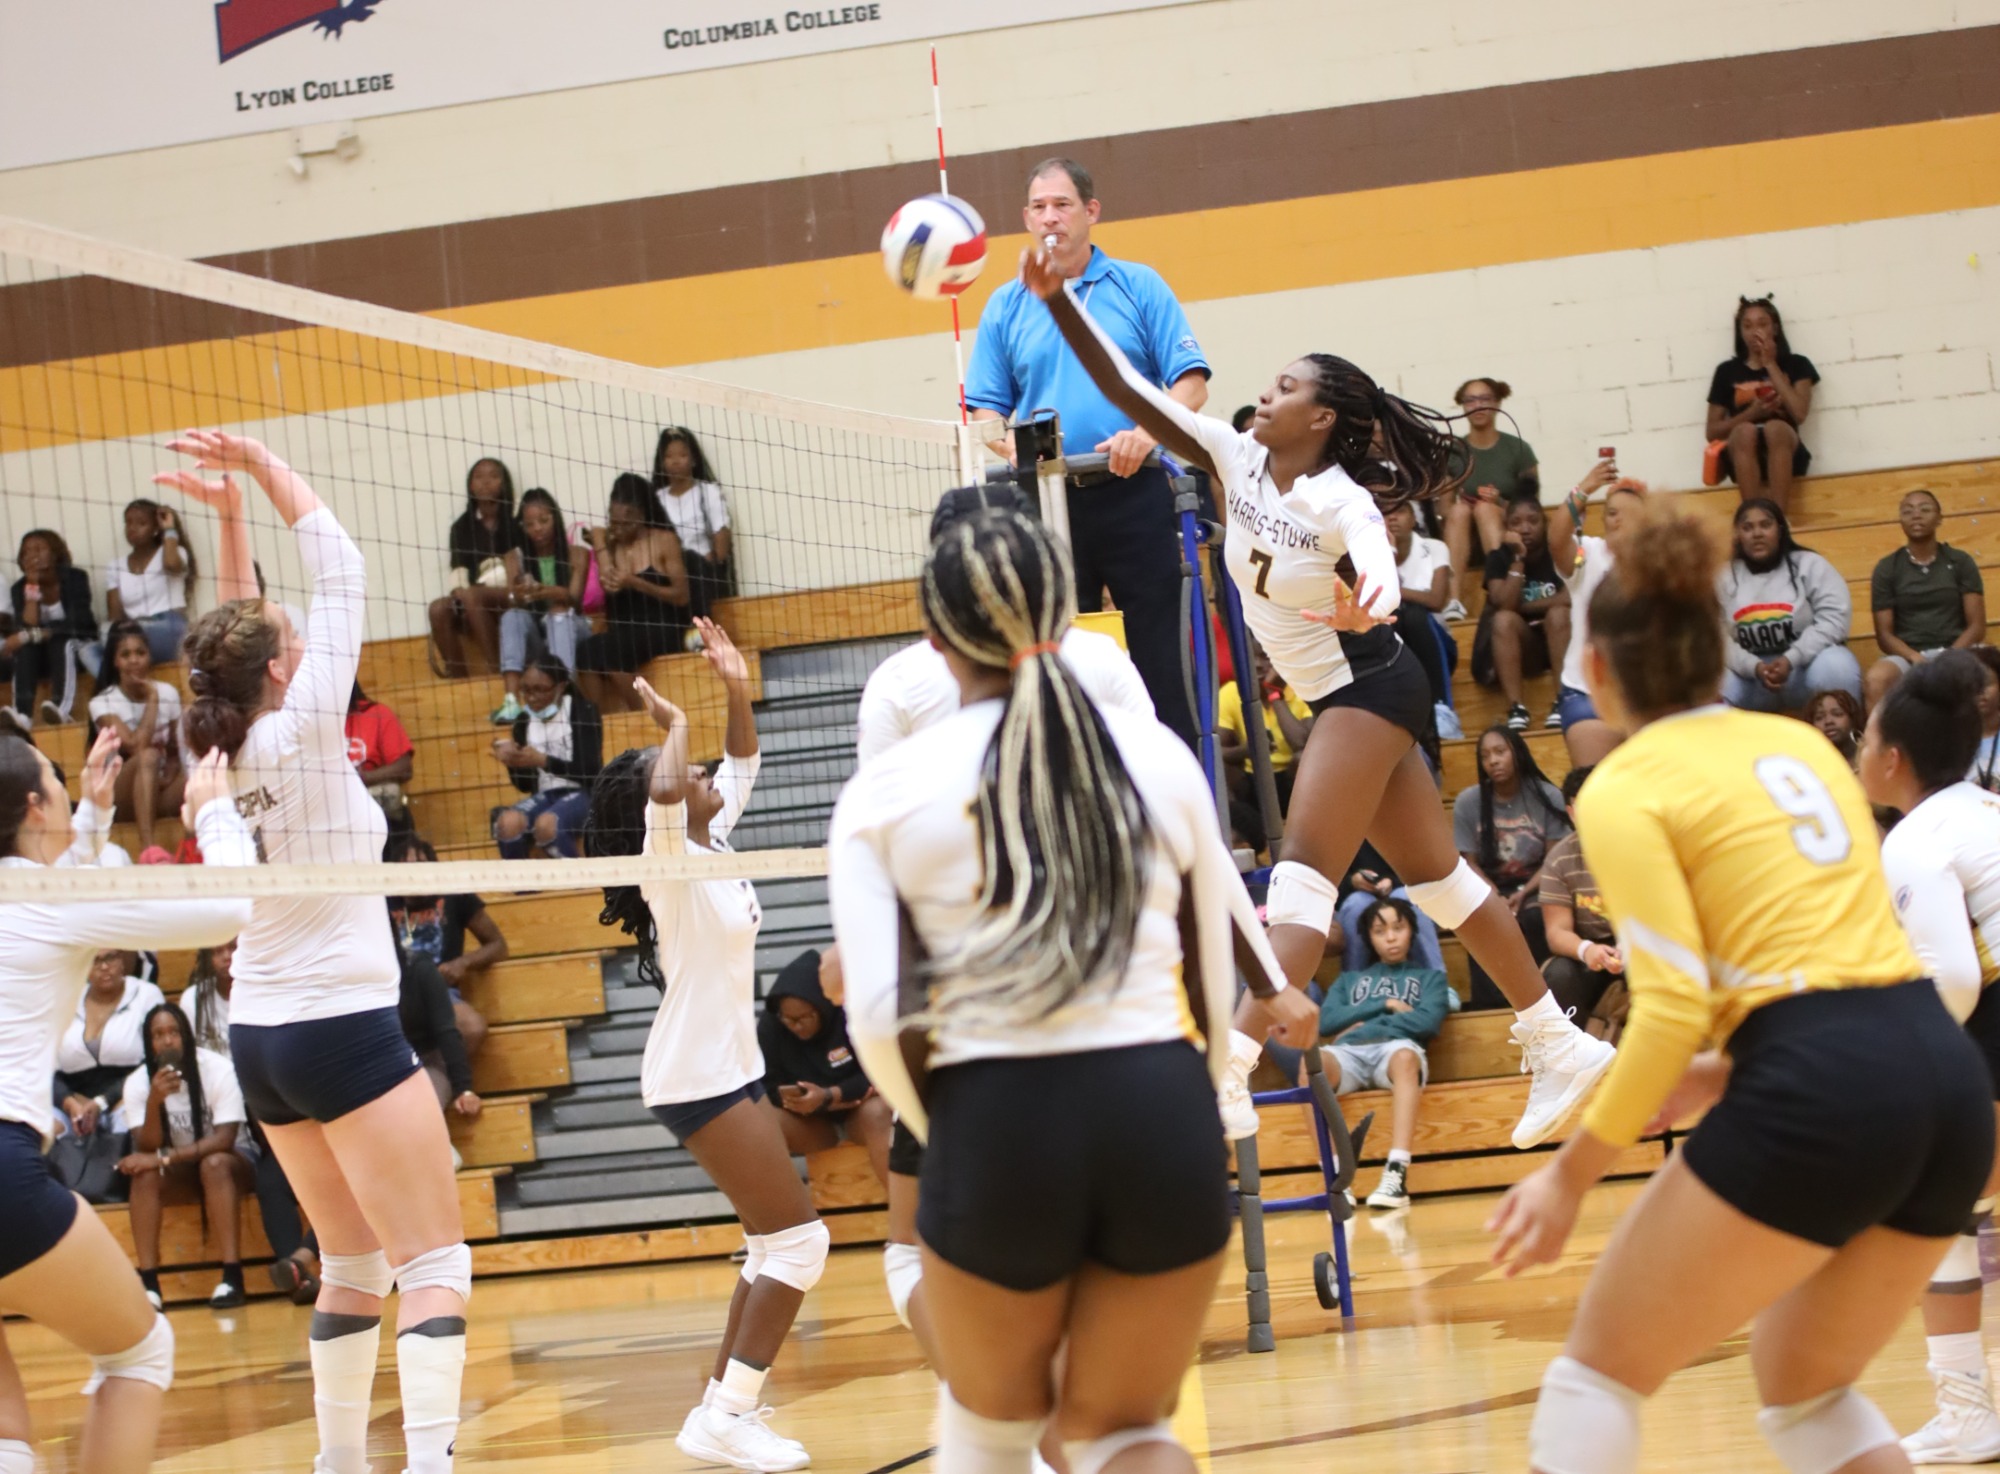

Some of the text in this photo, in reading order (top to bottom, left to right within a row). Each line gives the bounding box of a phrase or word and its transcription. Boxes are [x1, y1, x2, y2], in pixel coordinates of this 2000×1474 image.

[663, 3, 881, 49] COLUMBIA COLLEGE
[235, 73, 394, 111] LYON COLLEGE
[1248, 548, 1273, 600] 7
[1737, 620, 1798, 651] BLACK
[1752, 754, 1853, 867] 9
[1350, 975, 1421, 1007] GAP
